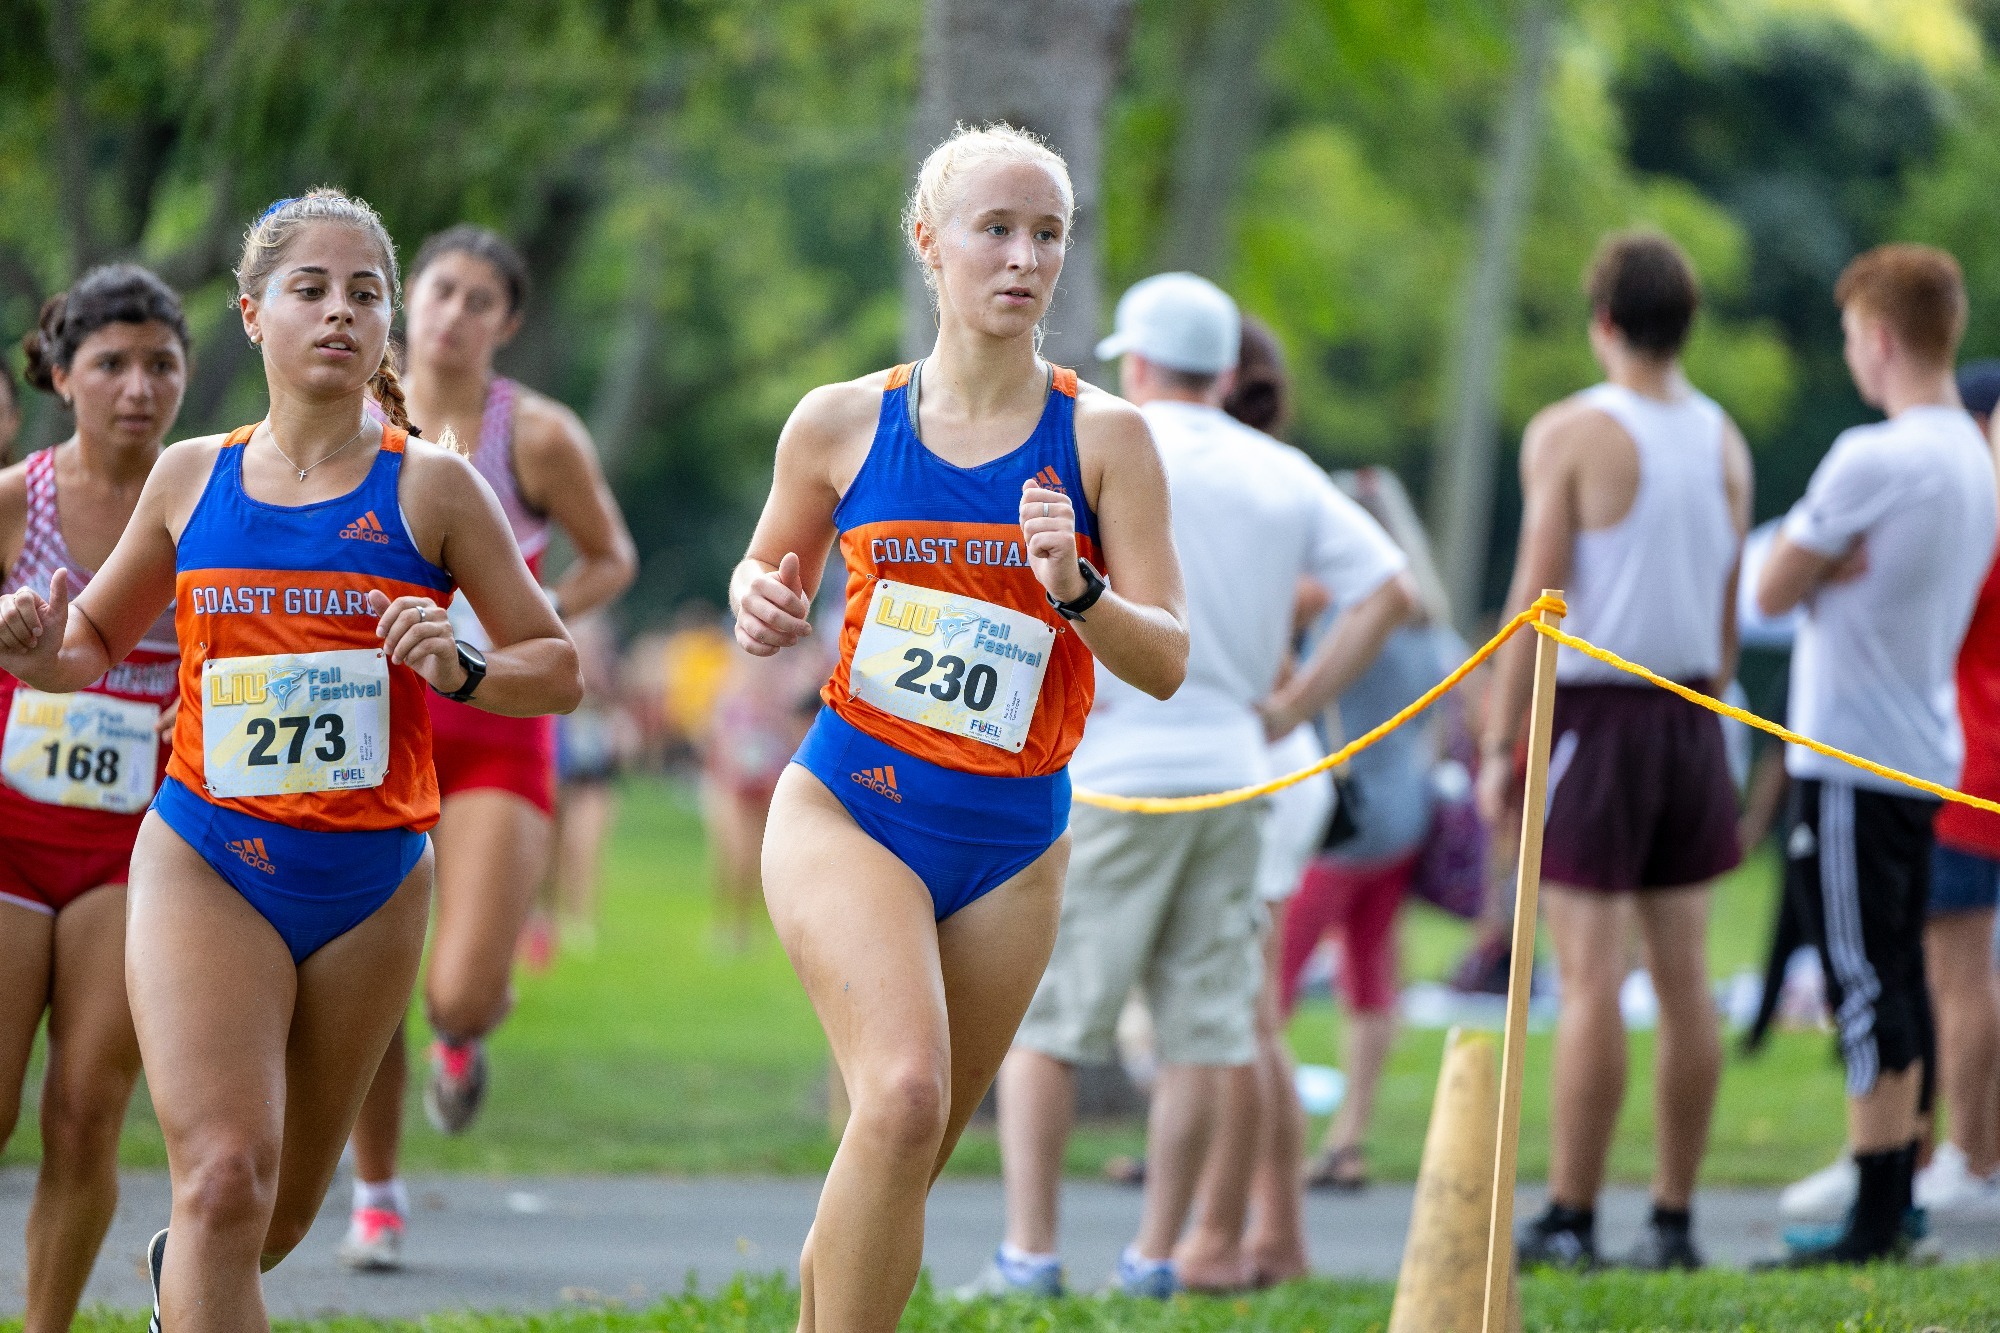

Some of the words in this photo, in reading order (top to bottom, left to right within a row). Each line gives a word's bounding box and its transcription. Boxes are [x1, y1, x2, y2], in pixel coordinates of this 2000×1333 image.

[339, 527, 389, 544] adidas
[871, 537, 958, 565] COAST
[965, 539, 1031, 568] GUA
[192, 586, 276, 615] COAST
[875, 596, 940, 636] LIU
[977, 617, 1011, 640] Fall
[973, 634, 1042, 668] Festival
[210, 673, 268, 706] LIU
[307, 667, 341, 684] Fall
[309, 680, 381, 701] Festival
[895, 647, 998, 712] 230
[247, 713, 346, 766] 273
[970, 719, 1000, 738] FUEL
[44, 740, 120, 785] 168
[333, 768, 365, 781] FUEL
[851, 773, 902, 803] adidas
